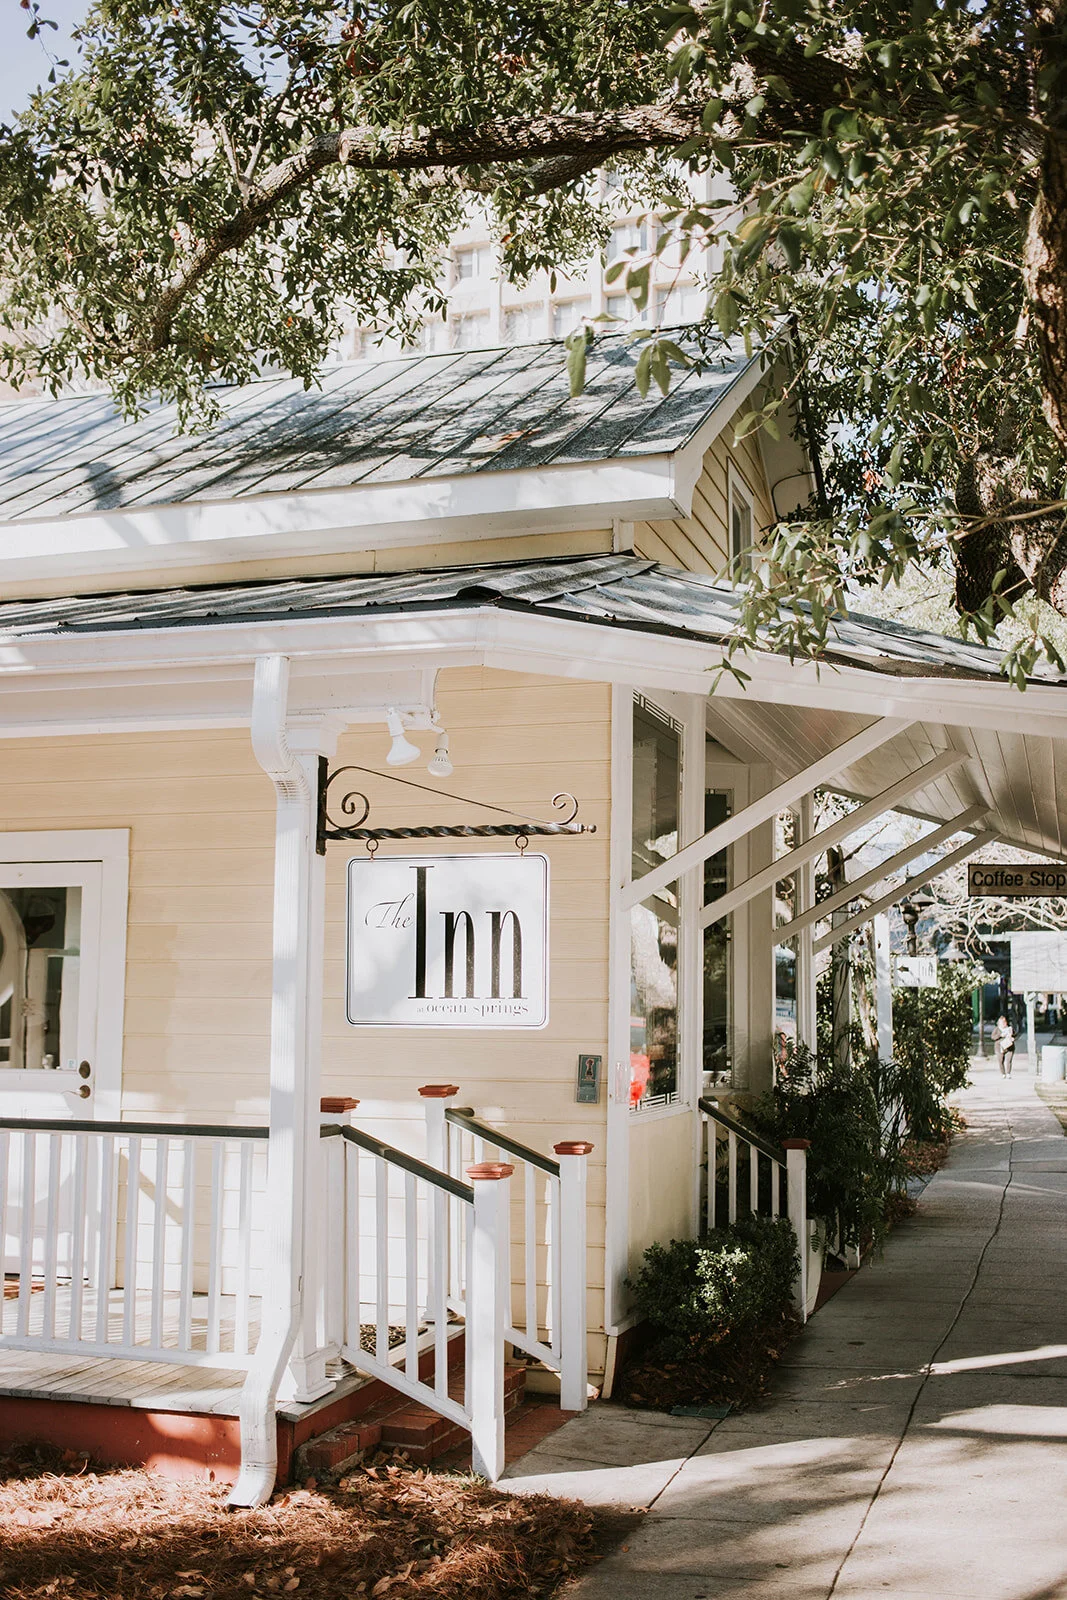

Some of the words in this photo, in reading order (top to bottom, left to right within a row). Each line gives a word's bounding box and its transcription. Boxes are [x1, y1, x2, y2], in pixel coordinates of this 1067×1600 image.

[972, 870, 1024, 887] Coffee
[1030, 870, 1067, 891] Stop
[364, 892, 415, 929] The
[407, 865, 528, 1000] Inn
[426, 1004, 467, 1014] ocean
[473, 1000, 529, 1017] springs
